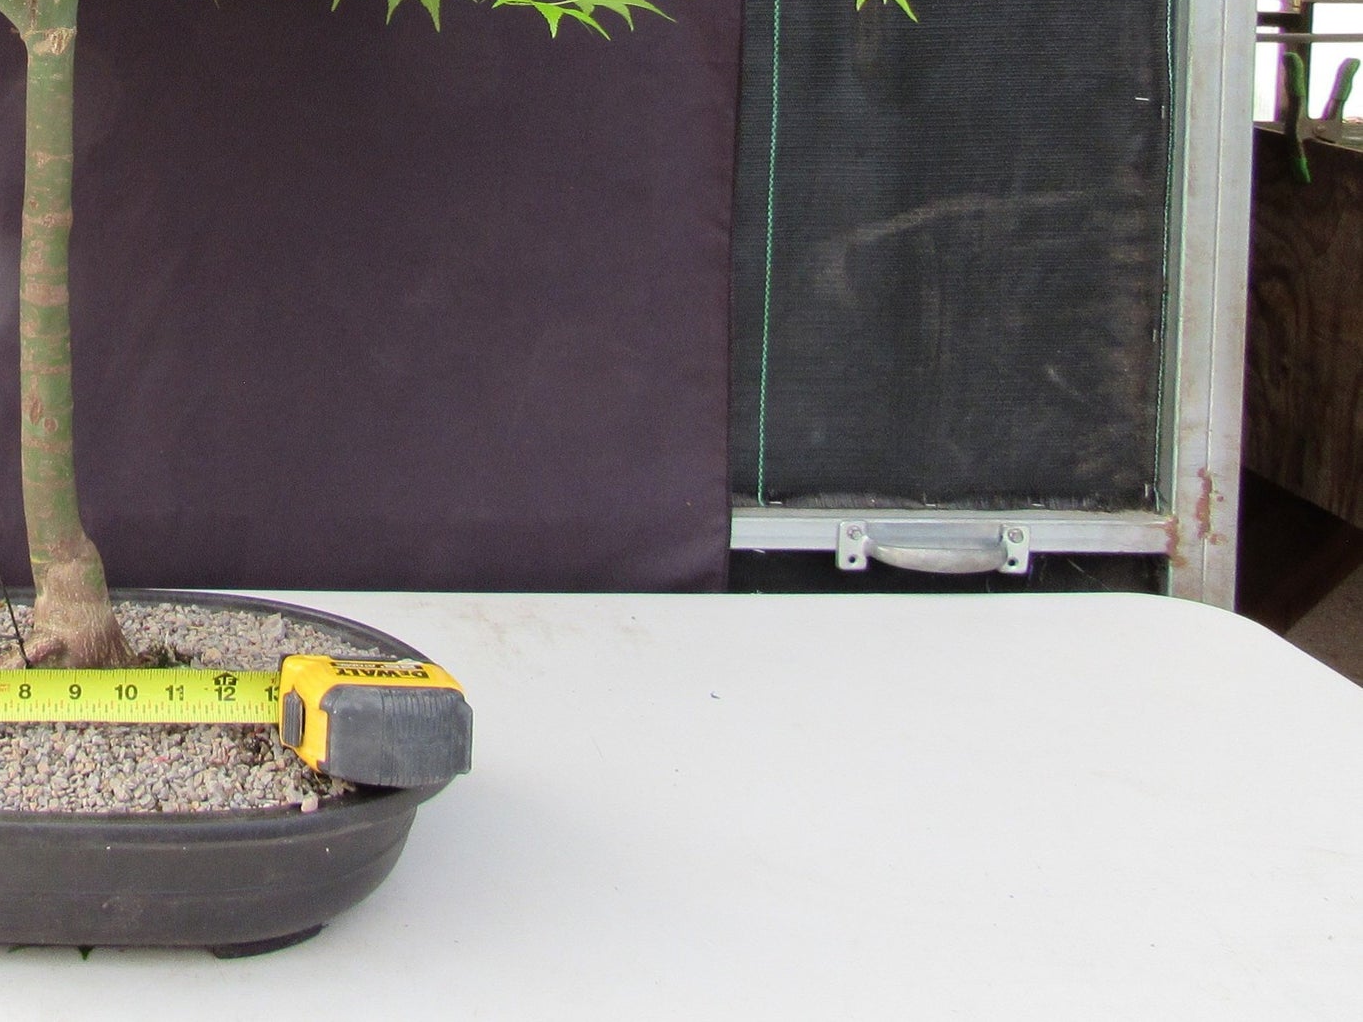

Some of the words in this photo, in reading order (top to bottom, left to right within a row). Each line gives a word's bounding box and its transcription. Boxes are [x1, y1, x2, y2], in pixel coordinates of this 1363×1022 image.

[18, 683, 32, 699] 8
[68, 683, 82, 700] 9
[114, 684, 138, 701] 10
[214, 685, 236, 702] 12
